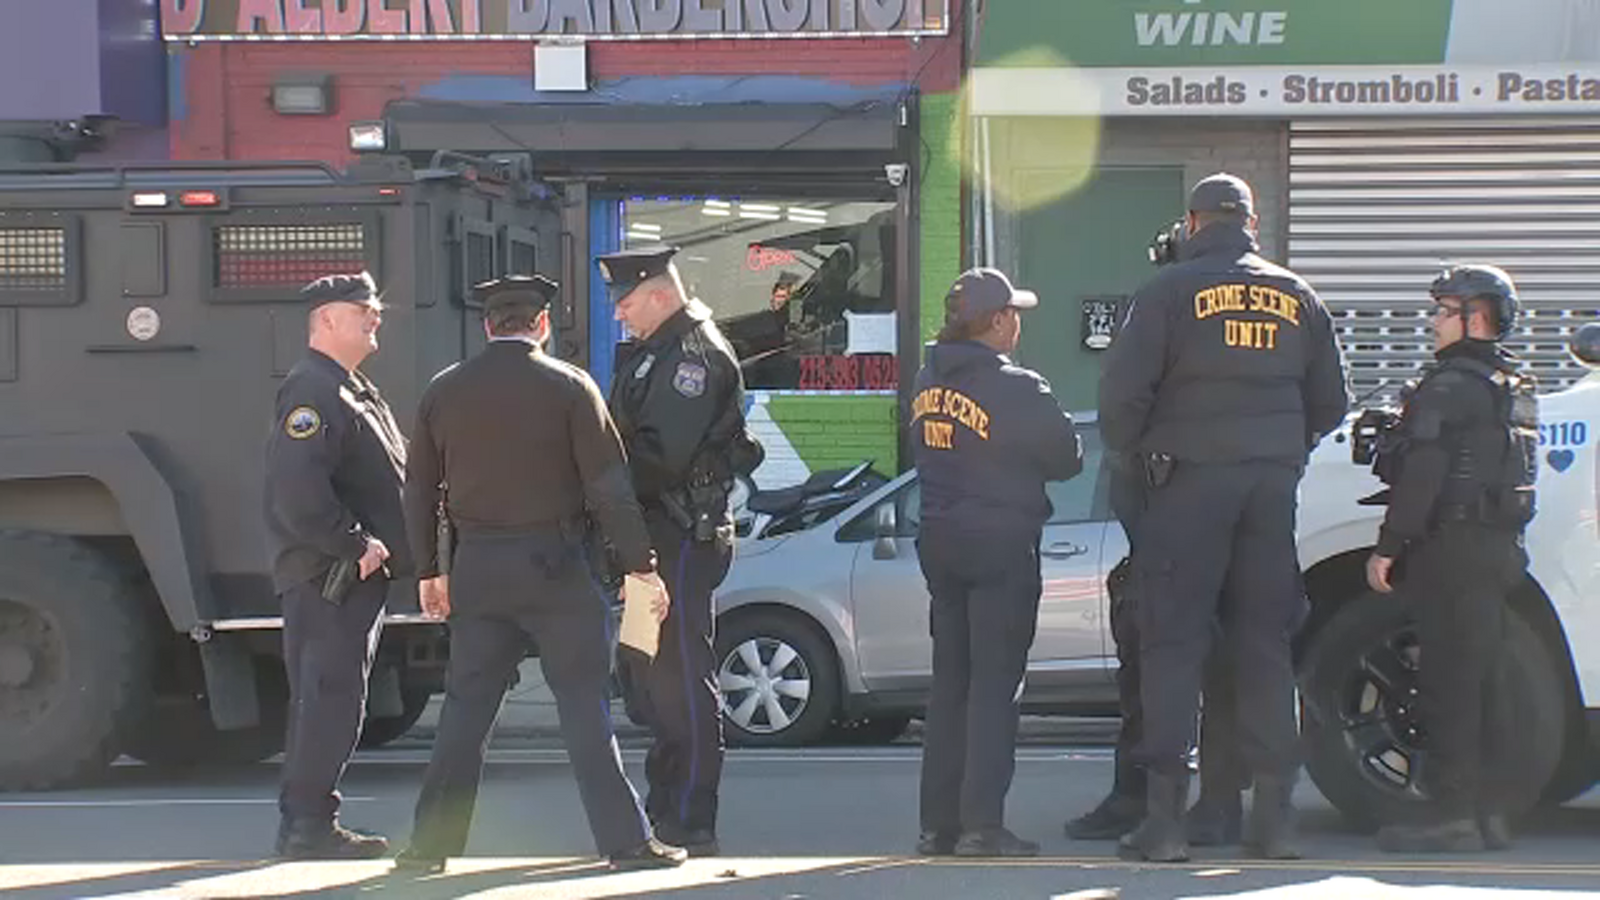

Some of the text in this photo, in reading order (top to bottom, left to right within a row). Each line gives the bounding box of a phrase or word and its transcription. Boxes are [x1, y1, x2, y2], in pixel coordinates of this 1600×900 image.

[1134, 12, 1287, 46] WINE
[1127, 72, 1600, 105] Salads Stromboli Pasta
[1195, 284, 1299, 326] CRIME SCENE
[1224, 320, 1278, 349] UNIT
[943, 389, 989, 440] SCENE
[924, 420, 953, 449] UNIT
